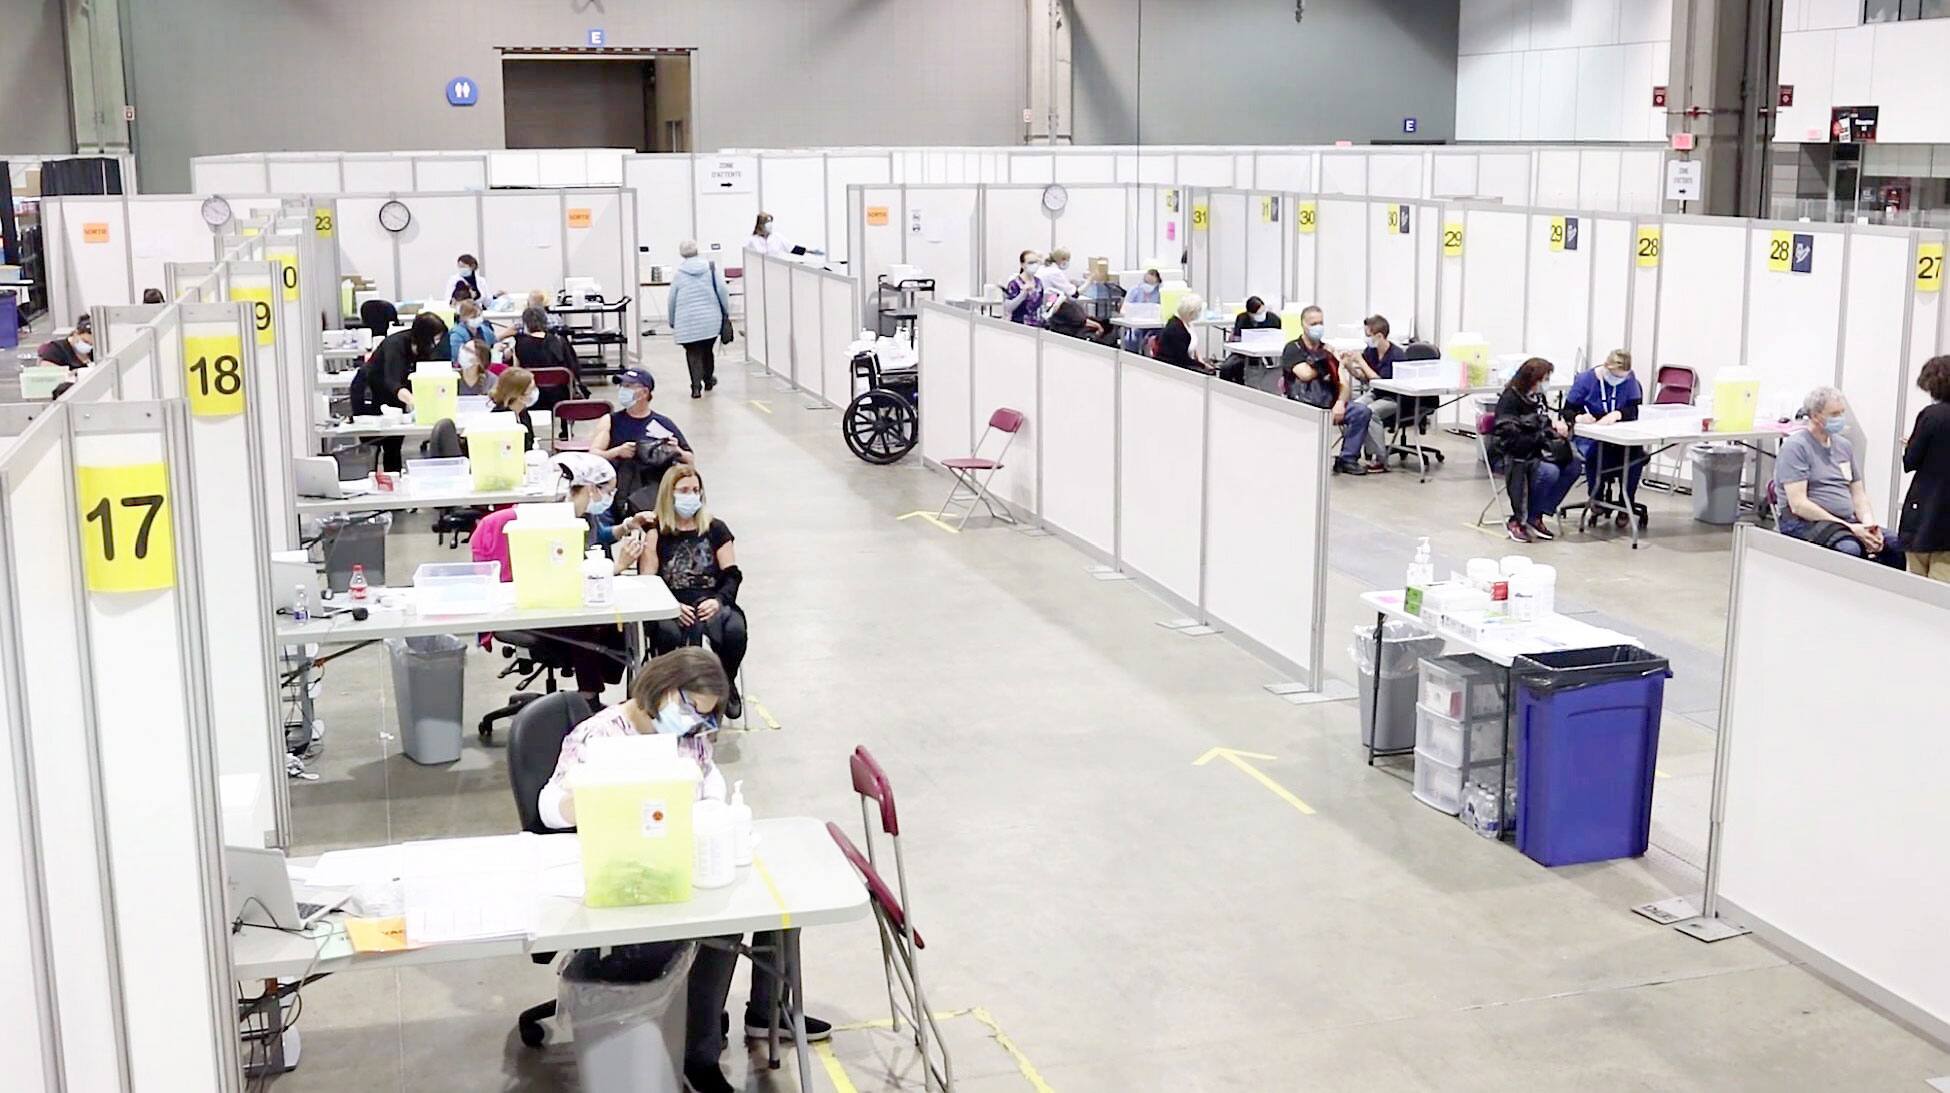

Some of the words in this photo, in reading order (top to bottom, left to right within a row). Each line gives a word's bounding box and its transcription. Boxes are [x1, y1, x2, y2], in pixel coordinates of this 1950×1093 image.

[591, 31, 602, 44] E
[1405, 120, 1415, 132] E
[315, 216, 332, 230] 23
[1193, 210, 1207, 223] 31
[1300, 210, 1316, 224] 30
[1444, 231, 1463, 247] 29
[1551, 225, 1563, 242] 29
[1638, 238, 1659, 257] 28
[1770, 239, 1790, 261] 28
[1918, 256, 1943, 279] 27
[283, 266, 297, 289] 0
[255, 301, 271, 331] 9
[189, 354, 241, 396] 18
[86, 495, 165, 561] 17
